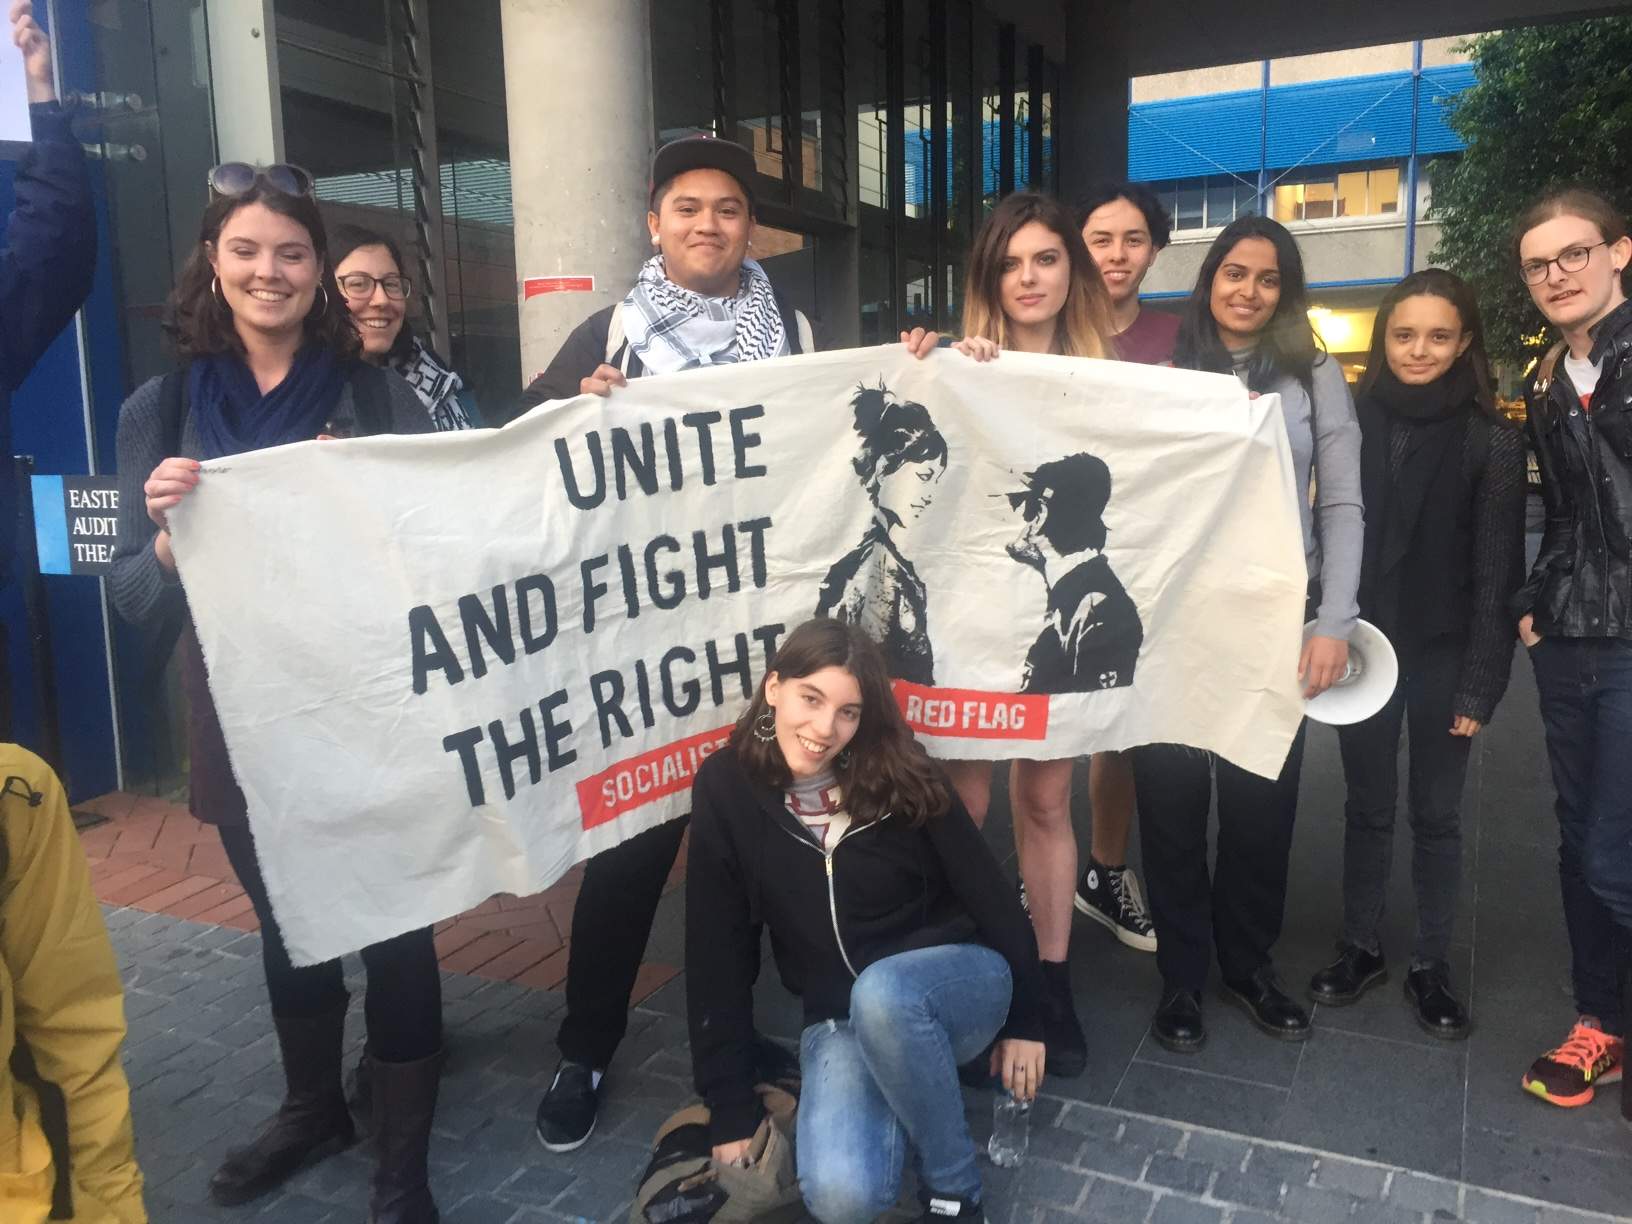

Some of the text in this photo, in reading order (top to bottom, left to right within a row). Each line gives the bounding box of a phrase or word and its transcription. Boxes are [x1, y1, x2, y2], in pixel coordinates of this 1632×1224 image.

[554, 404, 767, 511] UNITE
[72, 517, 118, 536] AUDIT
[408, 516, 773, 695] AND FIGHT
[443, 622, 786, 807] THE RIGHT
[905, 694, 1026, 731] RED FLAG
